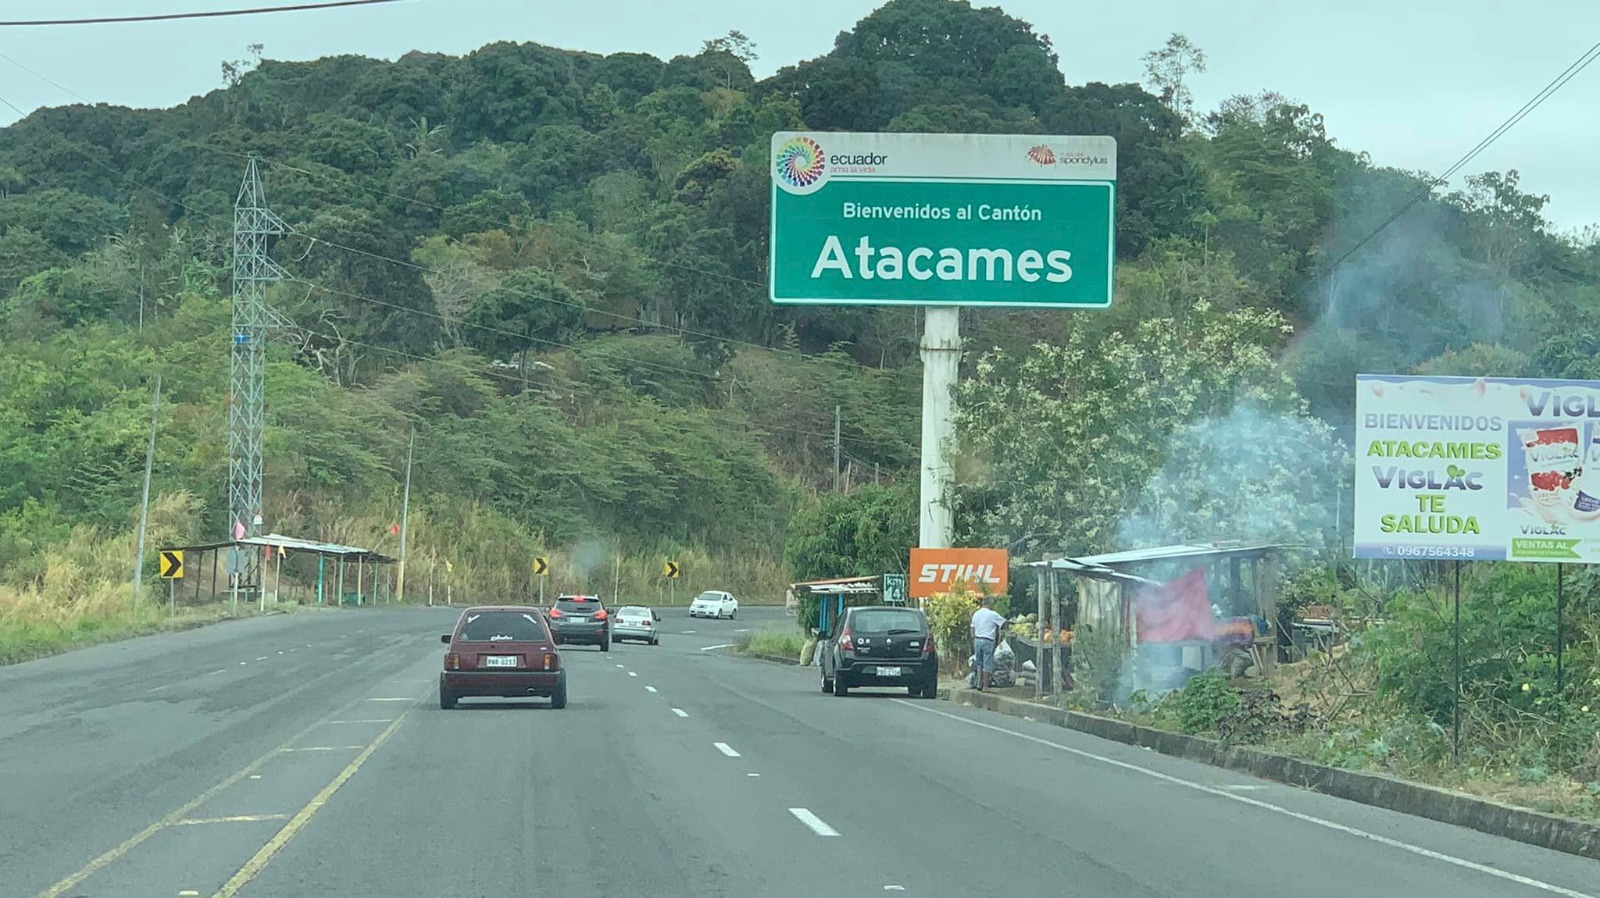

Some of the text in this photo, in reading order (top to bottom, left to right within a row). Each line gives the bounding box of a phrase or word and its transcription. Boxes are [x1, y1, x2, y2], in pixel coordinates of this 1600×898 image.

[830, 152, 888, 165] ecuador
[843, 202, 1042, 221] Bienvenidos al Cantón
[810, 235, 1073, 283] Atacames
[1364, 413, 1502, 432] BIENVENIDOS
[1367, 440, 1502, 460] ATACAMES
[1372, 465, 1484, 491] VIGLAC
[1415, 494, 1447, 514] TE
[1380, 513, 1481, 535] SALUDA
[1397, 545, 1475, 558] 0967564348
[1515, 540, 1570, 550] VENTAS AL
[918, 563, 1001, 584] STIHL
